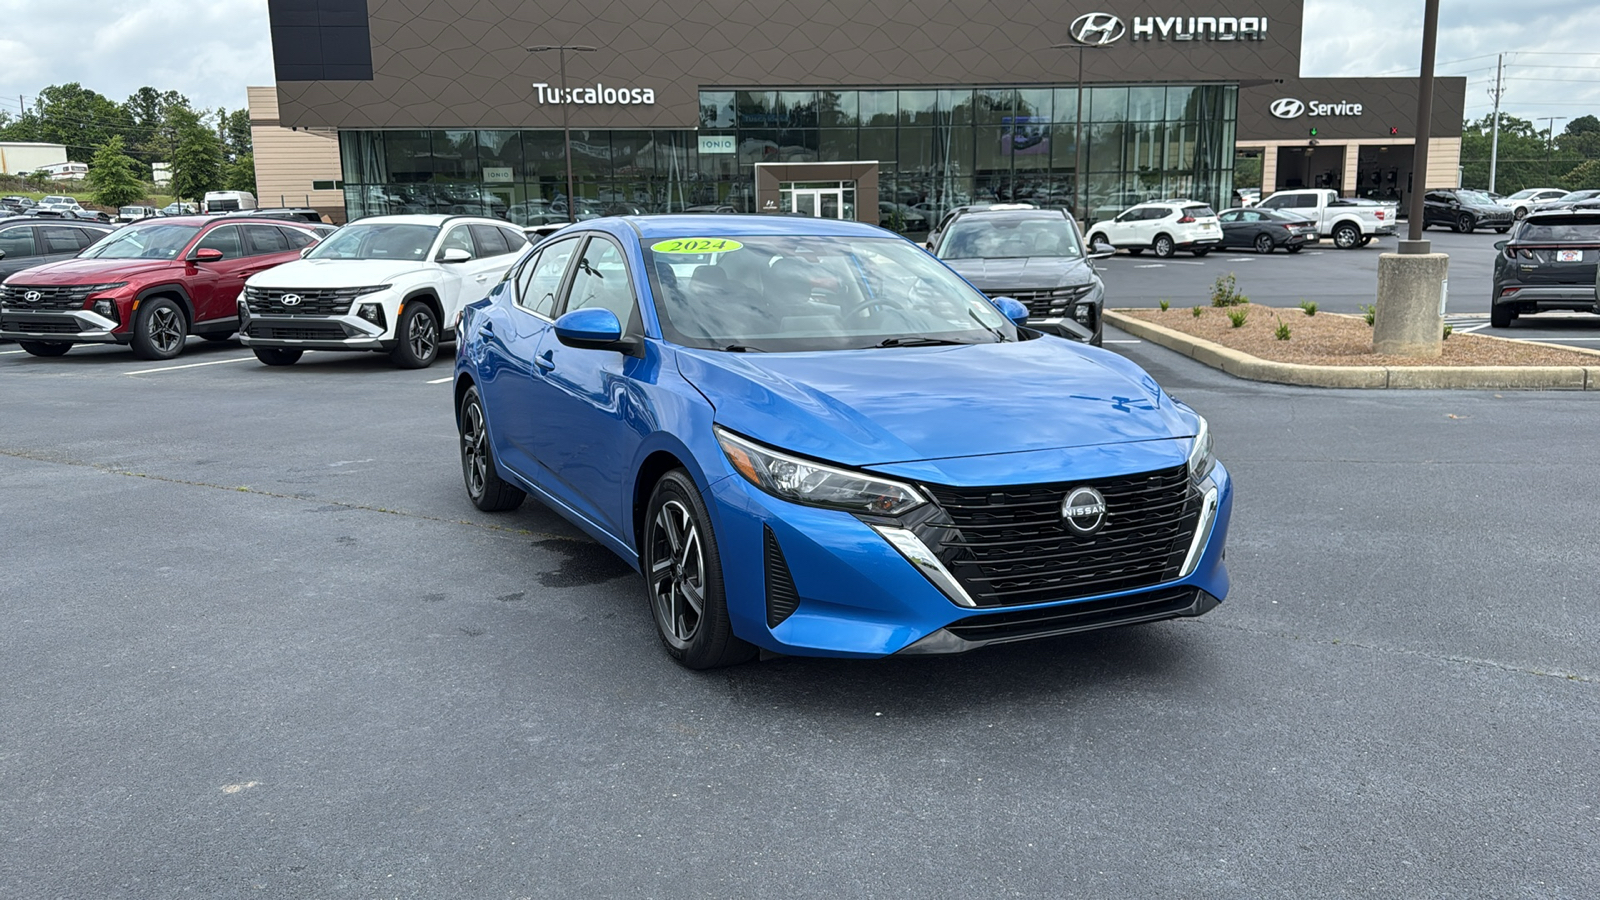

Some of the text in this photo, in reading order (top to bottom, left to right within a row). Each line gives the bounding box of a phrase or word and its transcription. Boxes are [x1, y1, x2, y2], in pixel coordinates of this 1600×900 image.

[1133, 16, 1268, 41] HYUNDAI
[532, 83, 655, 104] Tuscaloosa
[1308, 100, 1363, 116] Service
[669, 240, 727, 252] 2024
[1062, 505, 1106, 517] NISSAN
